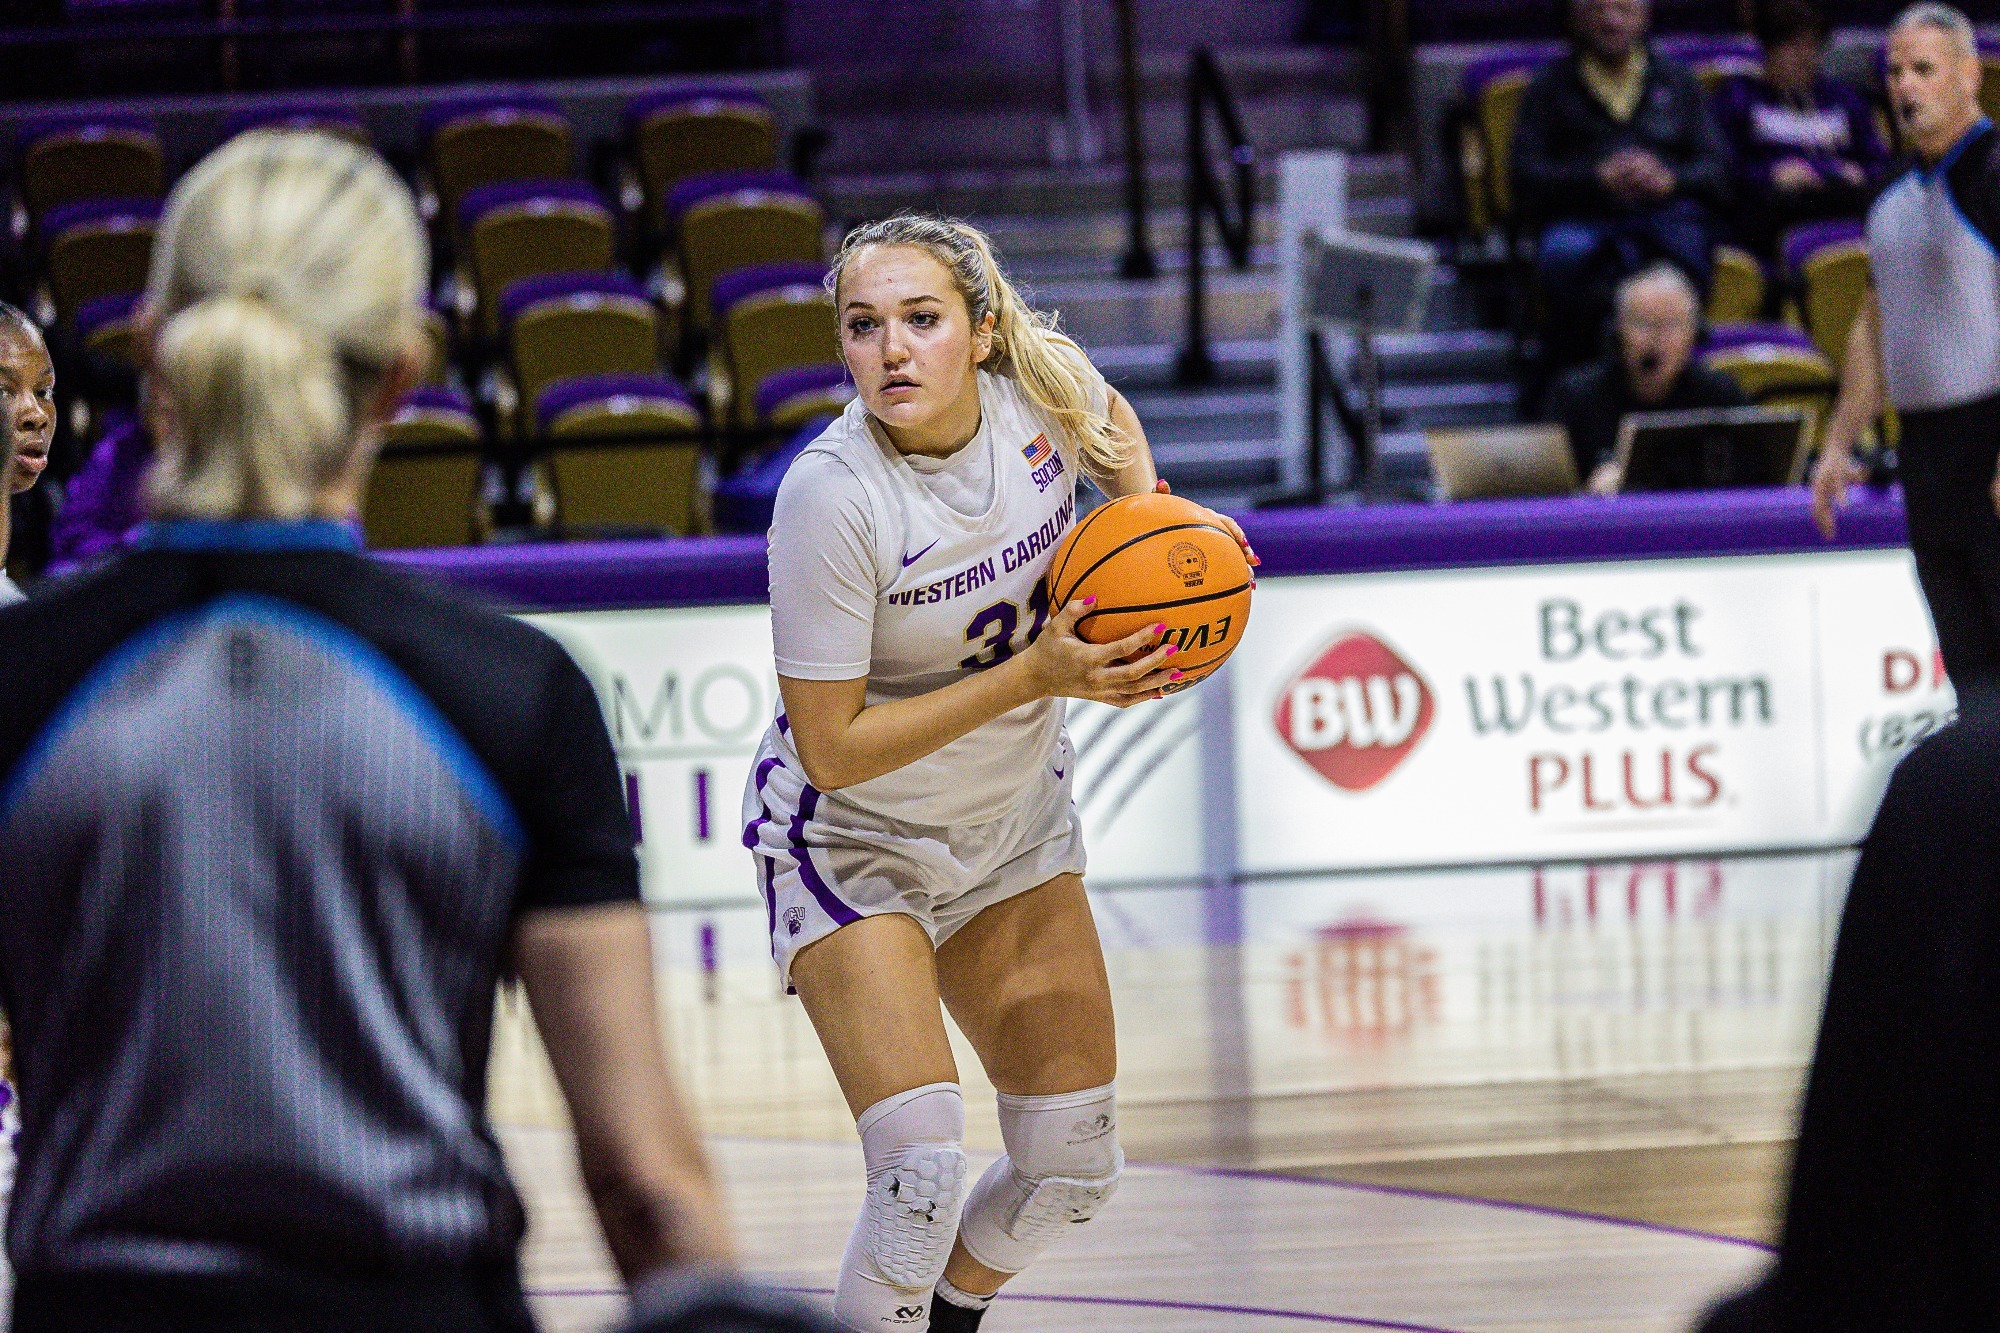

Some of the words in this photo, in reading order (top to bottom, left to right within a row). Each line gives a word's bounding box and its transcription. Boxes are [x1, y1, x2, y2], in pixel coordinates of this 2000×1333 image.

[888, 557, 996, 606] WESTERN
[1001, 491, 1074, 573] CAROLINA
[1537, 595, 1704, 663] Best
[611, 661, 778, 744] MO
[1290, 671, 1424, 753] BW
[1463, 671, 1775, 737] Western
[1528, 742, 1722, 813] PLUS
